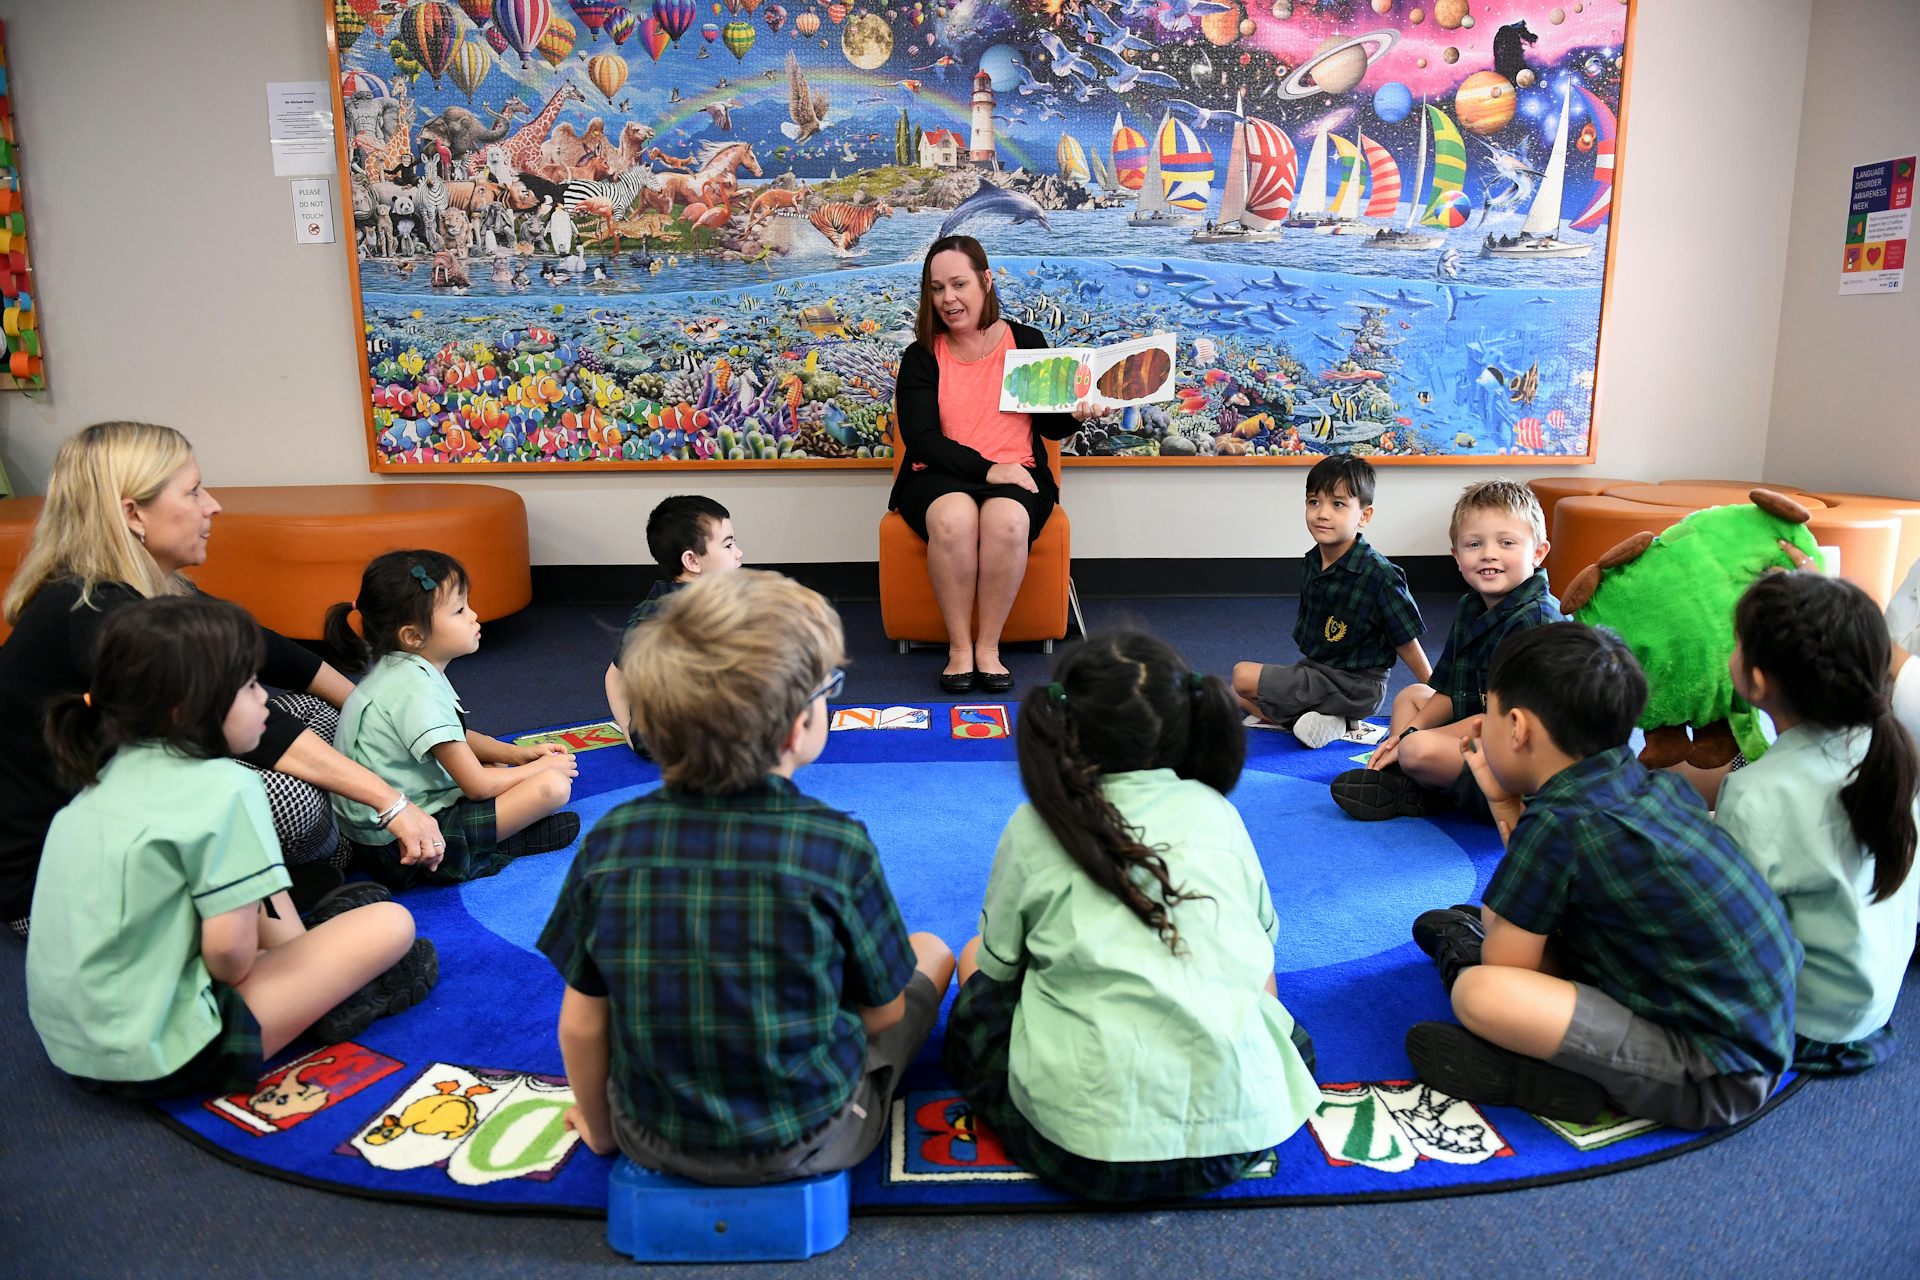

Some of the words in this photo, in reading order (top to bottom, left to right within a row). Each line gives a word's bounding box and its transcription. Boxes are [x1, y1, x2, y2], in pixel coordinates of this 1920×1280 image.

[1856, 167, 1885, 180] LANGUAGE
[1855, 178, 1882, 190] DISORDER
[1854, 188, 1887, 200] AWARENESS
[1853, 201, 1869, 210] WEEK
[836, 710, 877, 727] N
[953, 723, 1003, 739] O
[559, 727, 627, 750] K
